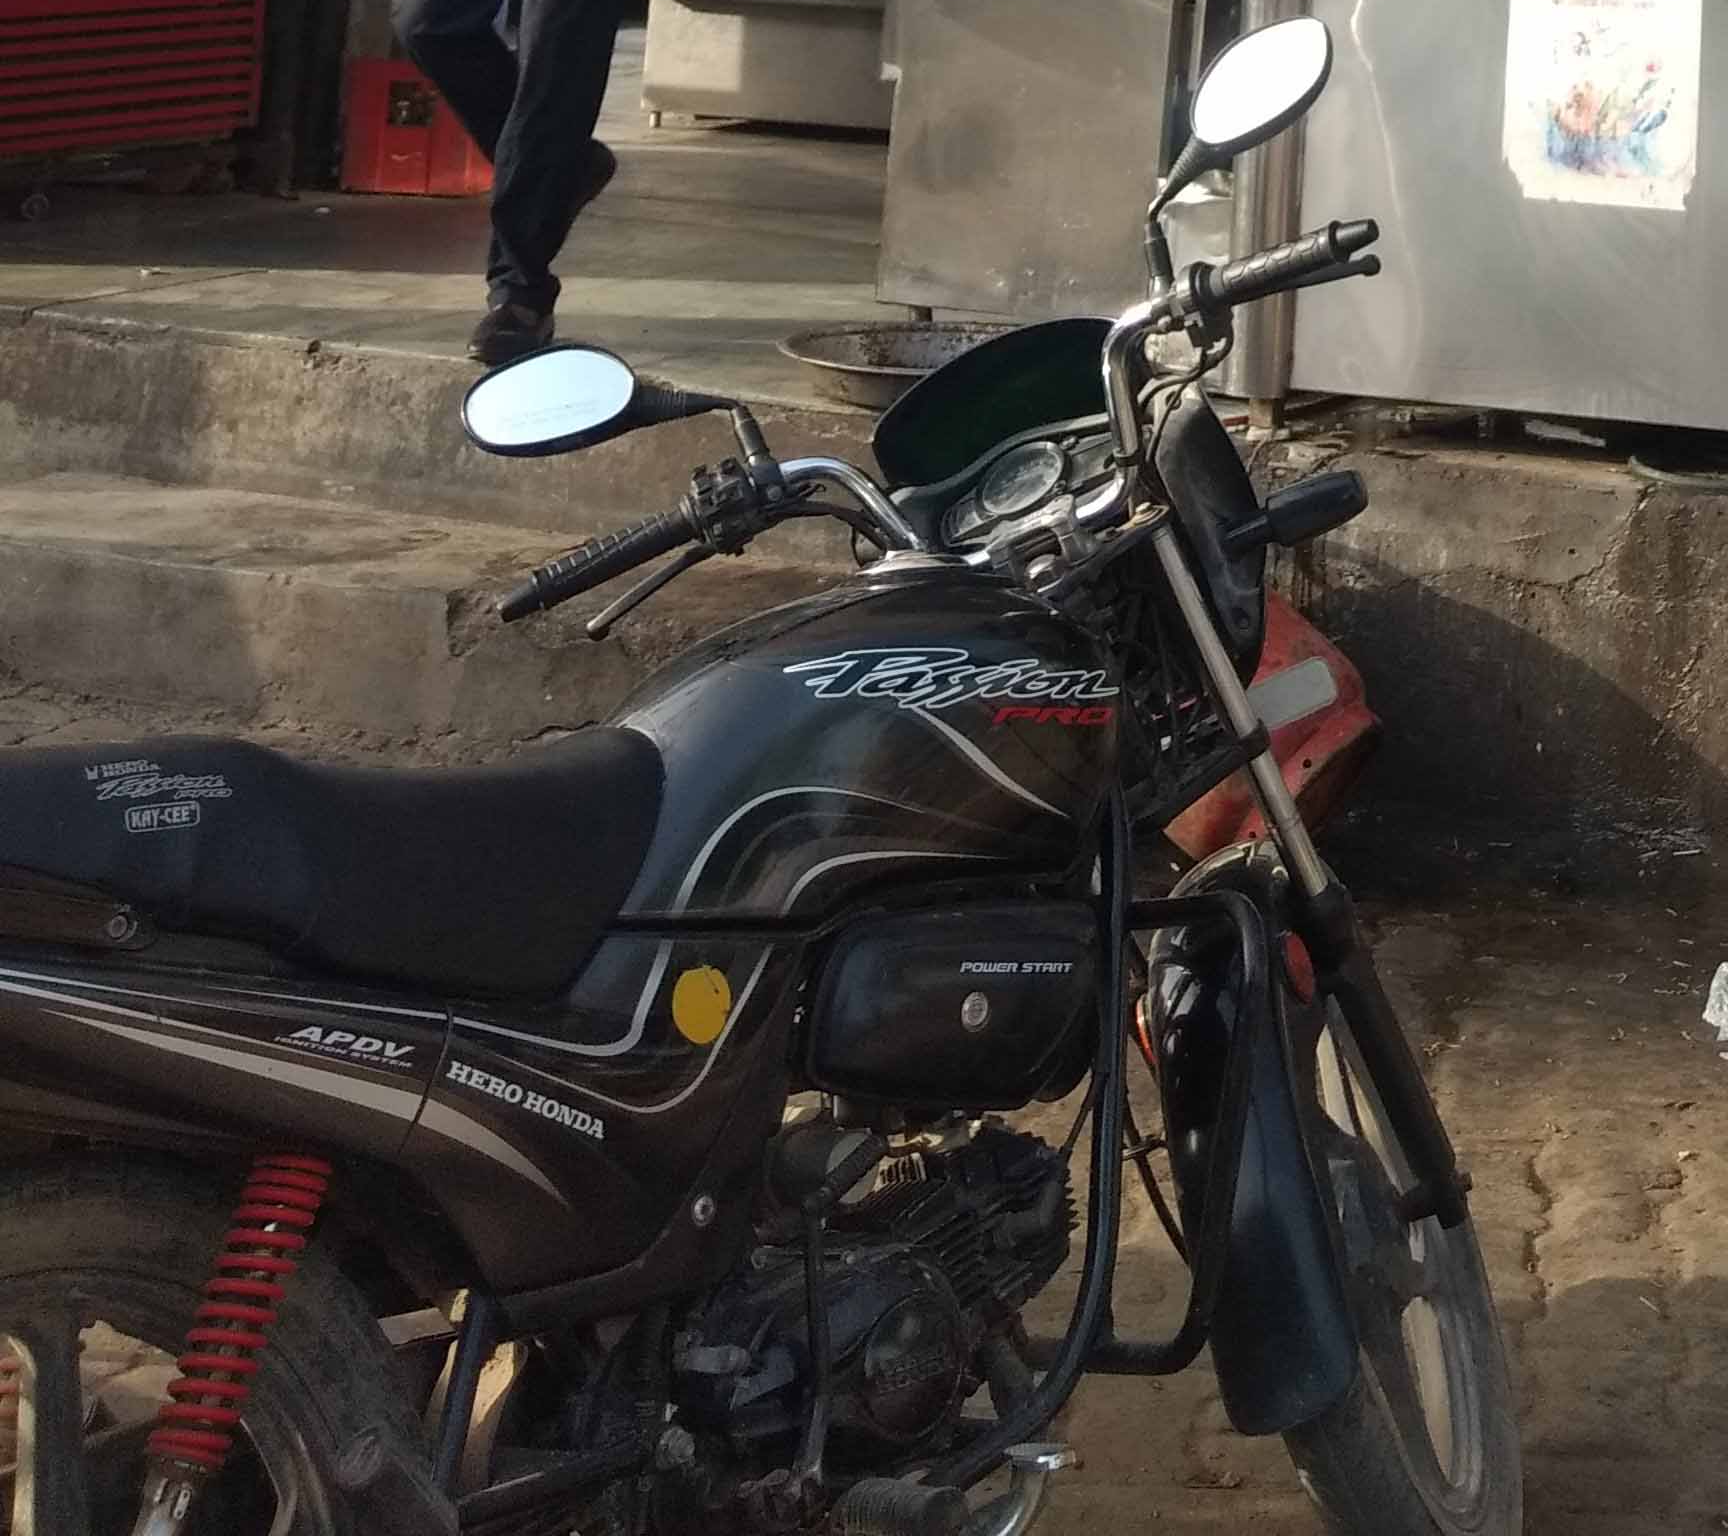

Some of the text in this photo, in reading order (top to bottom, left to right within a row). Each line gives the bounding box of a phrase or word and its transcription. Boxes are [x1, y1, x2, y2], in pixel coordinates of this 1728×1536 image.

[783, 647, 1119, 709] Passion
[994, 706, 1113, 727] PRO
[131, 804, 192, 829] KAY-CEE
[960, 961, 1073, 973] POWER START
[289, 1026, 415, 1059] APDV
[446, 1060, 605, 1140] HERO HONDA
